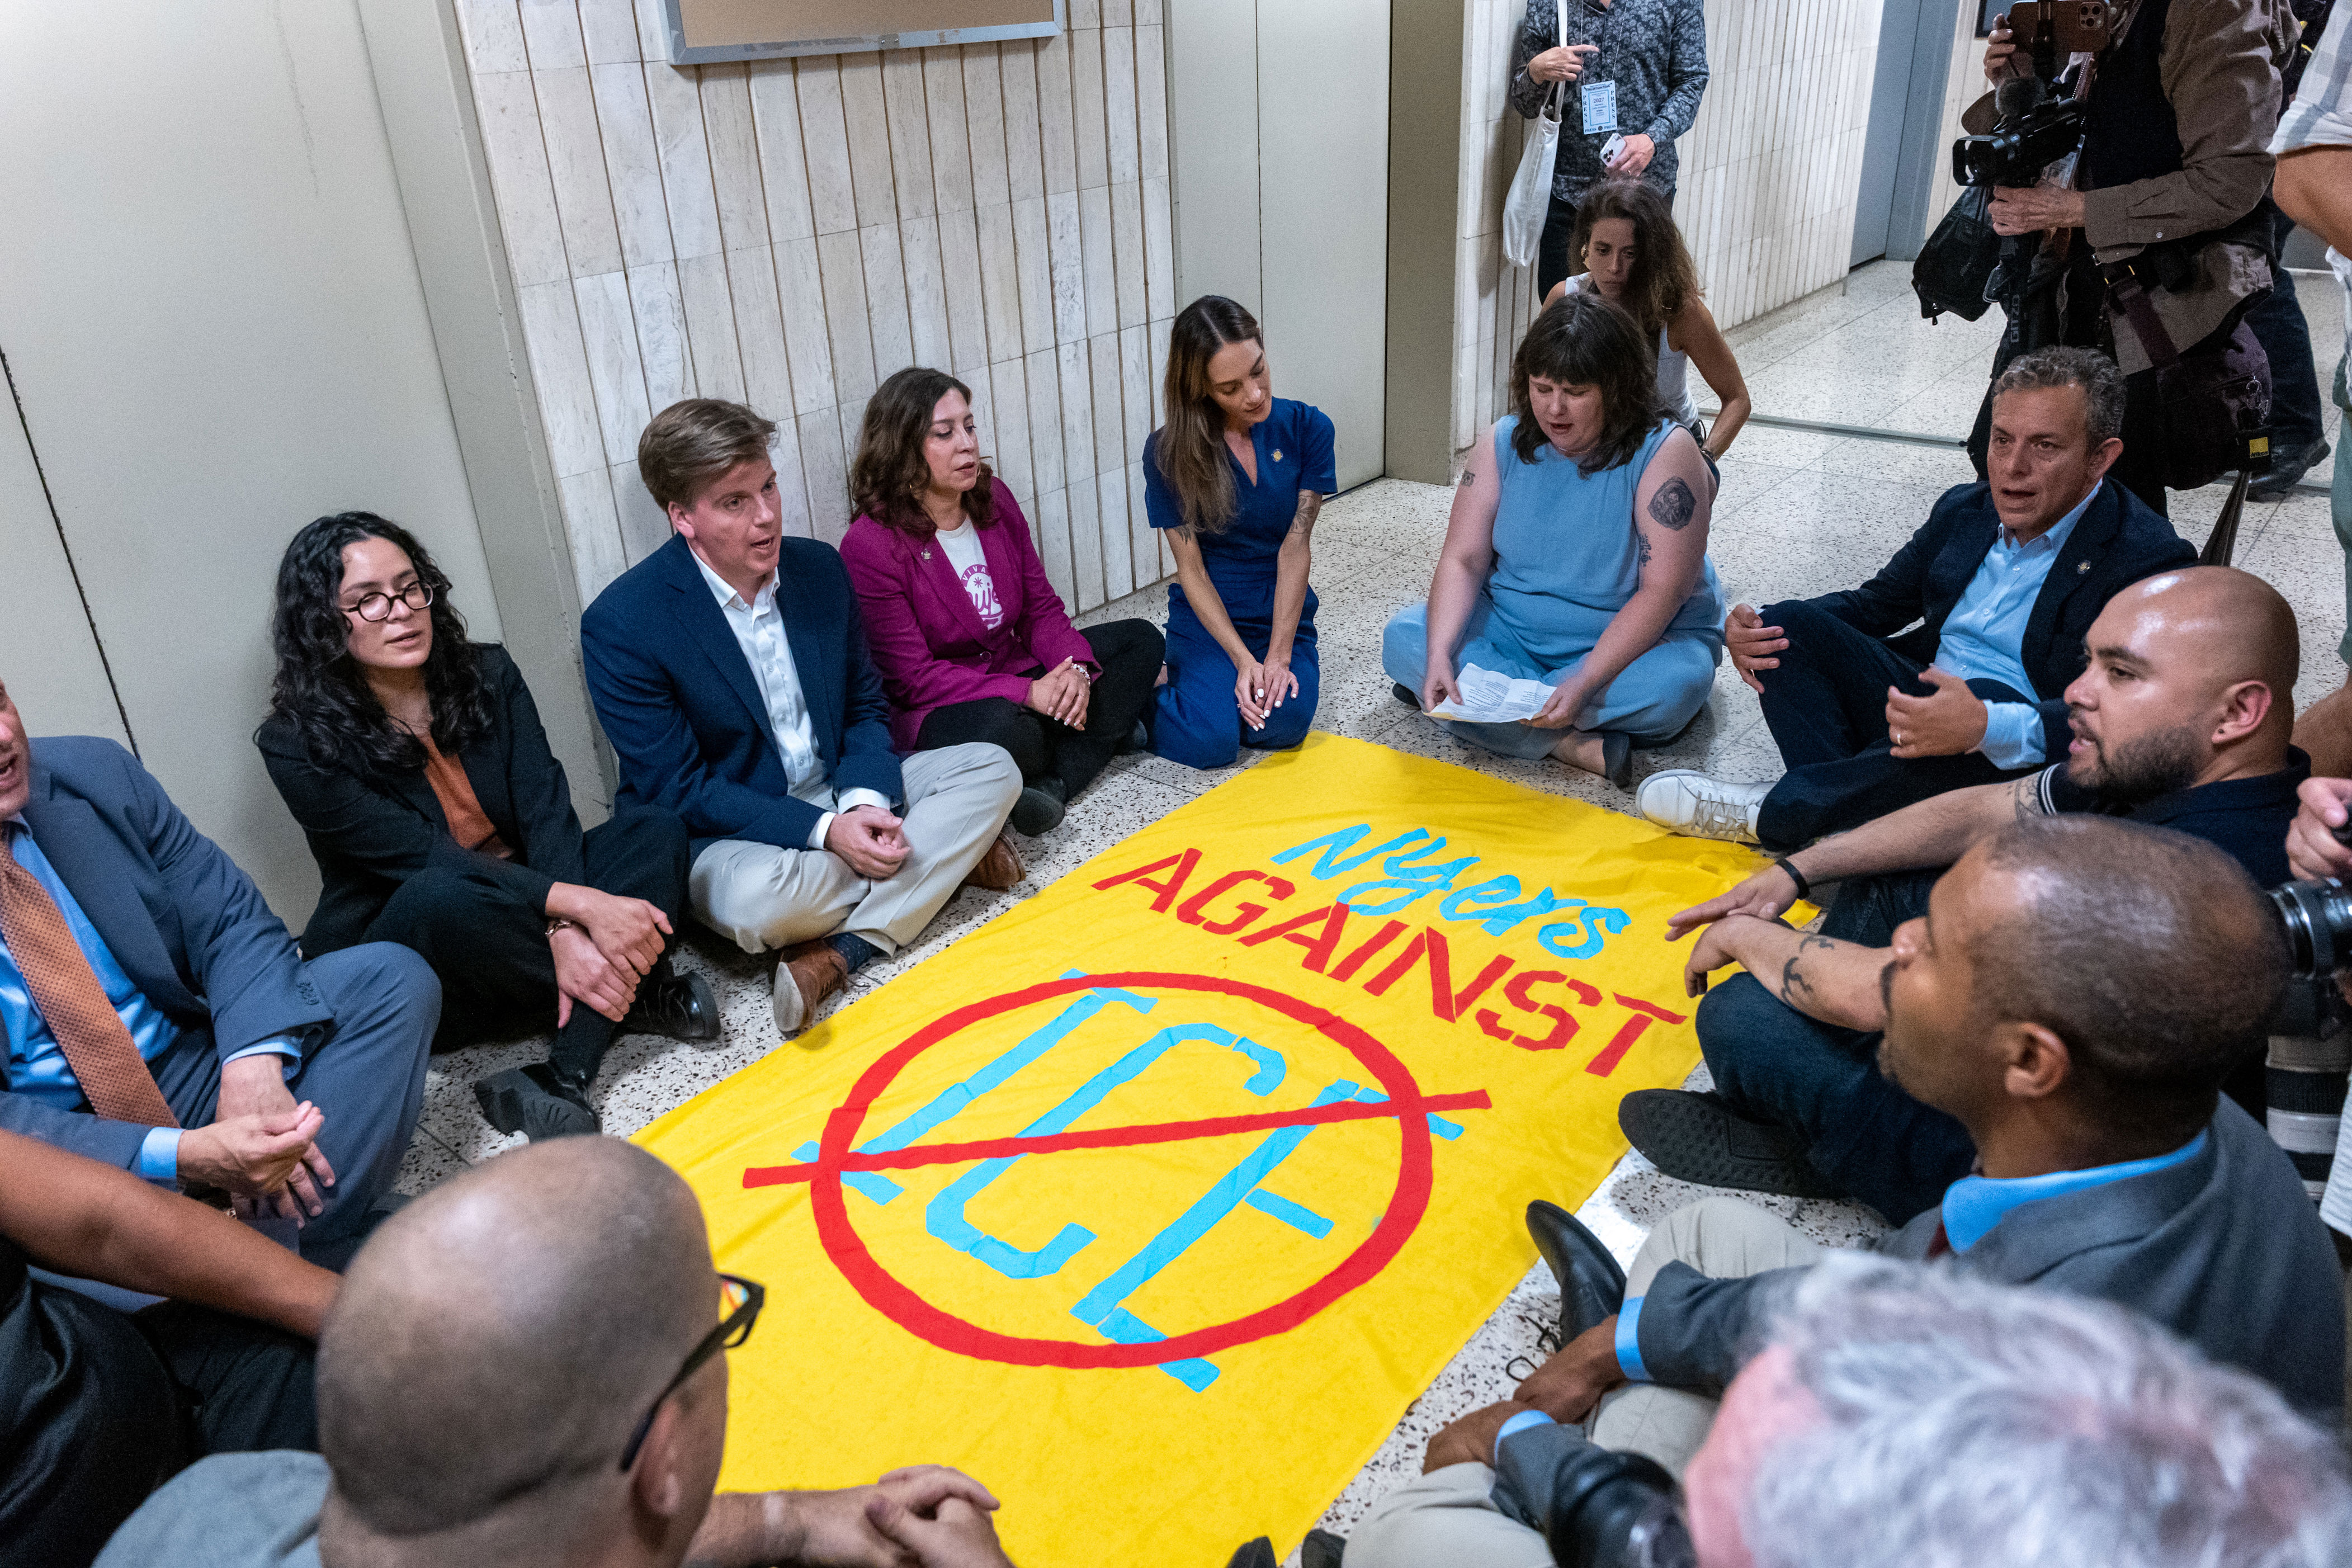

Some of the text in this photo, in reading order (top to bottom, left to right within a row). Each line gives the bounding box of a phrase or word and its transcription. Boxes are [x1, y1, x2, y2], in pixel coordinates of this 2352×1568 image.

[2010, 294, 2020, 343] GITZO
[962, 565, 986, 581] VIVA
[1091, 848, 1688, 1078] AGAINST
[791, 967, 1465, 1392] ICE
